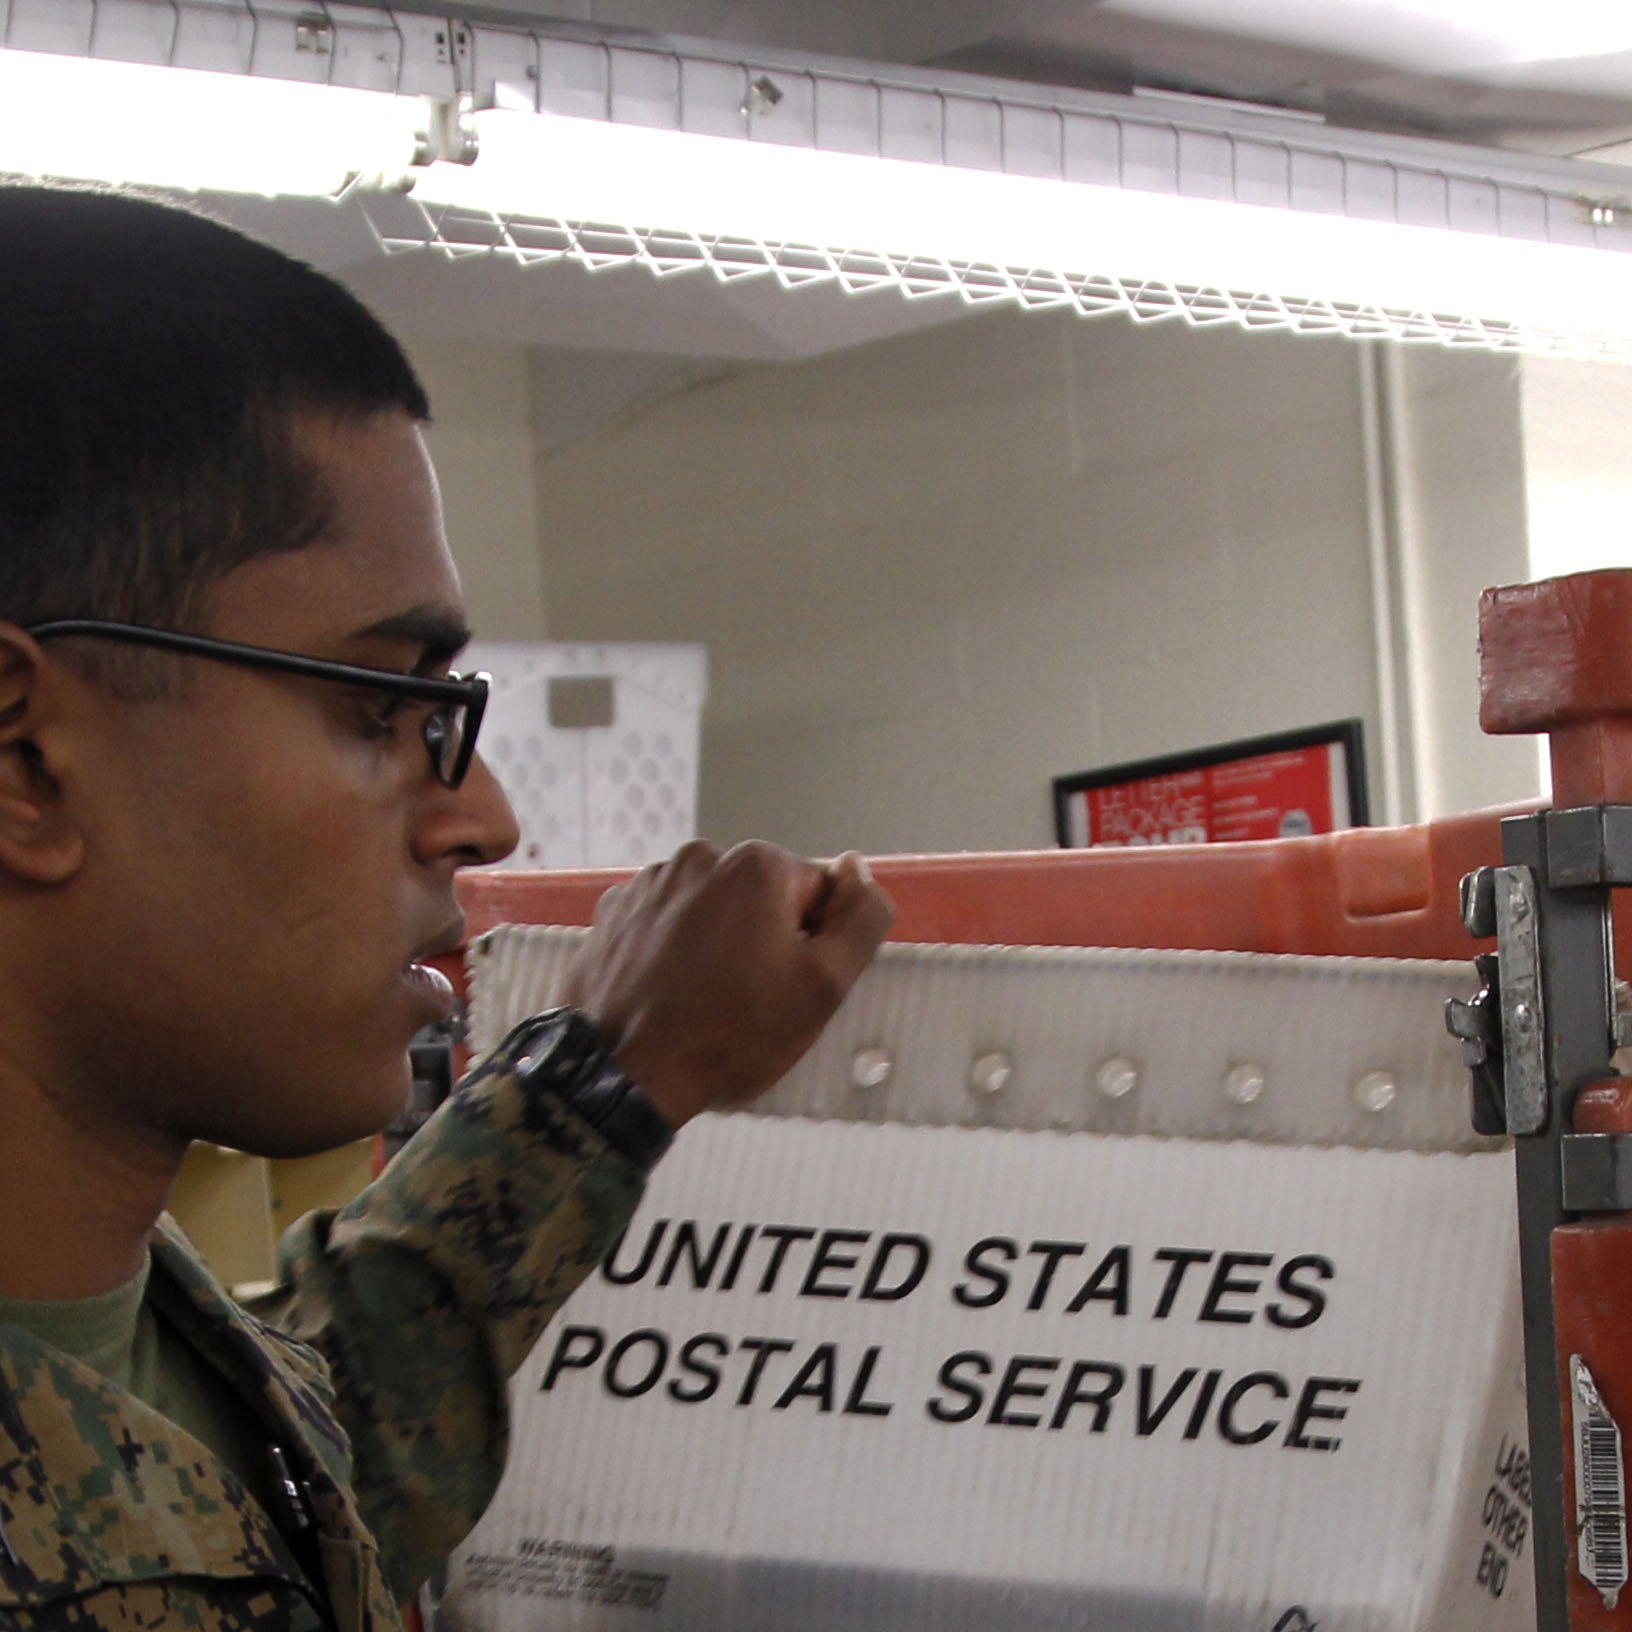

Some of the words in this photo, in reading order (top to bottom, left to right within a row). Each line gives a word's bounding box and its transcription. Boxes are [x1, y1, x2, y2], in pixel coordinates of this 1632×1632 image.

[603, 1218, 931, 1302] UNITED
[951, 1235, 1336, 1330] STATES
[540, 1324, 894, 1417] POSTAL
[925, 1349, 1363, 1454] SERVICE
